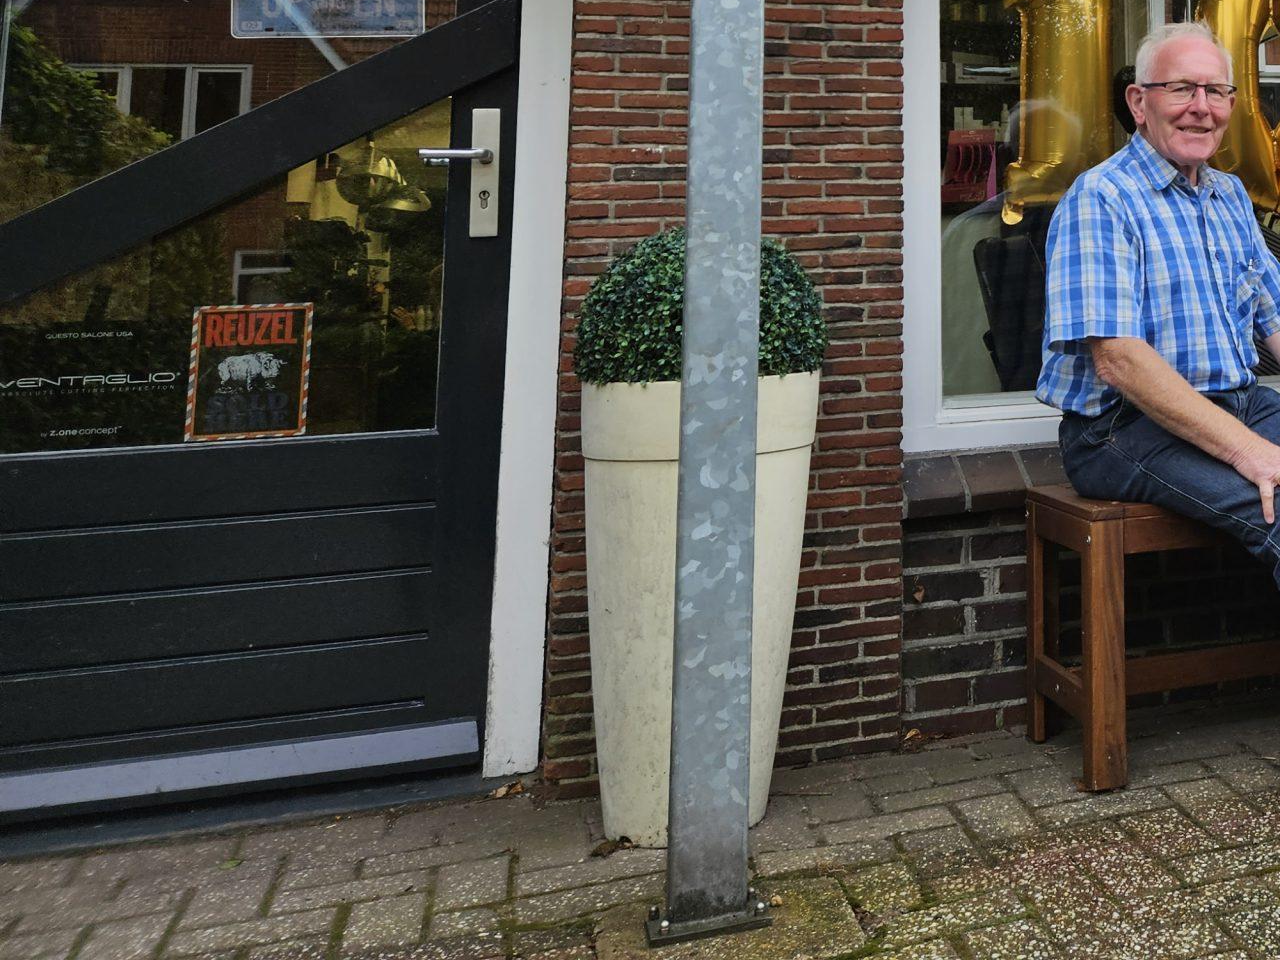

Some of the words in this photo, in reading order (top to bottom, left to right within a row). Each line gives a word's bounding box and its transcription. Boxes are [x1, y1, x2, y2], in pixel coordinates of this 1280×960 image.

[205, 311, 297, 348] REUZEL
[45, 332, 79, 340] QUESTO
[81, 330, 114, 339] SALONE
[111, 384, 175, 393] PERFECTION
[50, 427, 78, 437] z.one
